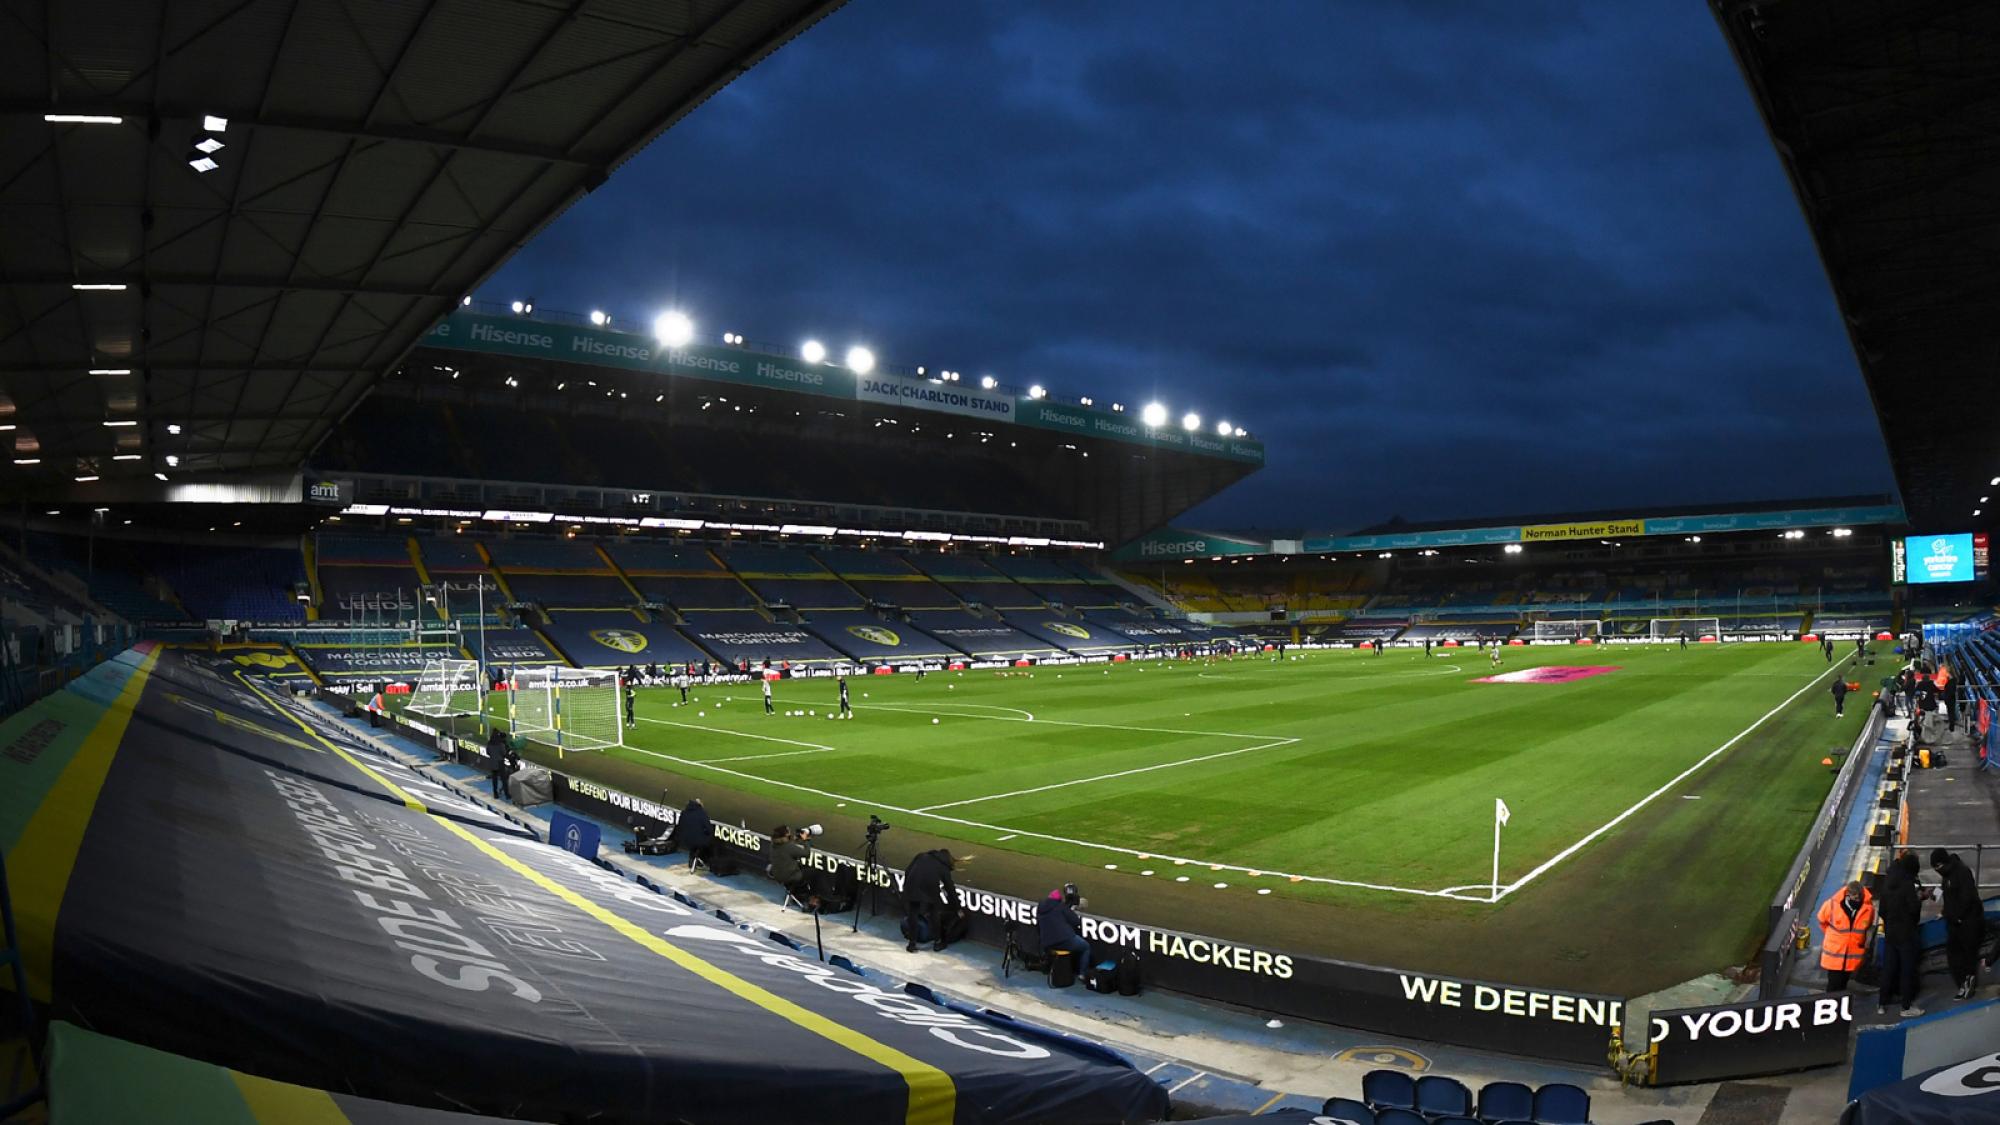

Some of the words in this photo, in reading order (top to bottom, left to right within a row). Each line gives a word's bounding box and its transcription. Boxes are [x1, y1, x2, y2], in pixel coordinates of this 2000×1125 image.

[470, 323, 553, 348] Hisense
[572, 335, 650, 361] Hisense
[668, 350, 740, 373] Hisense
[756, 362, 824, 385] Hisense
[863, 379, 898, 397] JACK
[902, 386, 968, 407] CHARLTON
[971, 397, 1010, 414] STAND
[1039, 408, 1087, 428] Hisense
[1095, 418, 1137, 437] Hisense
[1144, 426, 1182, 444] Hisense
[1189, 436, 1225, 452] Hisense
[310, 485, 339, 497] amt
[1525, 528, 1566, 539] Norman
[1568, 525, 1605, 537] Hunter
[1608, 524, 1640, 535] Stand
[1141, 539, 1206, 555] Hisense
[327, 651, 422, 661] MARCHING
[343, 658, 443, 667] TOGETHER
[355, 683, 374, 693] Sell
[567, 777, 580, 792] WE
[579, 779, 608, 802] DEFEND
[608, 790, 631, 811] YOUR
[631, 796, 675, 826] BUSINESS
[714, 823, 761, 851] ACKERS
[352, 888, 542, 1005] SIDE
[1080, 916, 1142, 951] ROM
[1148, 930, 1294, 980] HACKERS
[731, 944, 1051, 1059] Clipper
[1399, 974, 1462, 1007] WE
[1681, 1003, 1801, 1041] YOUR
